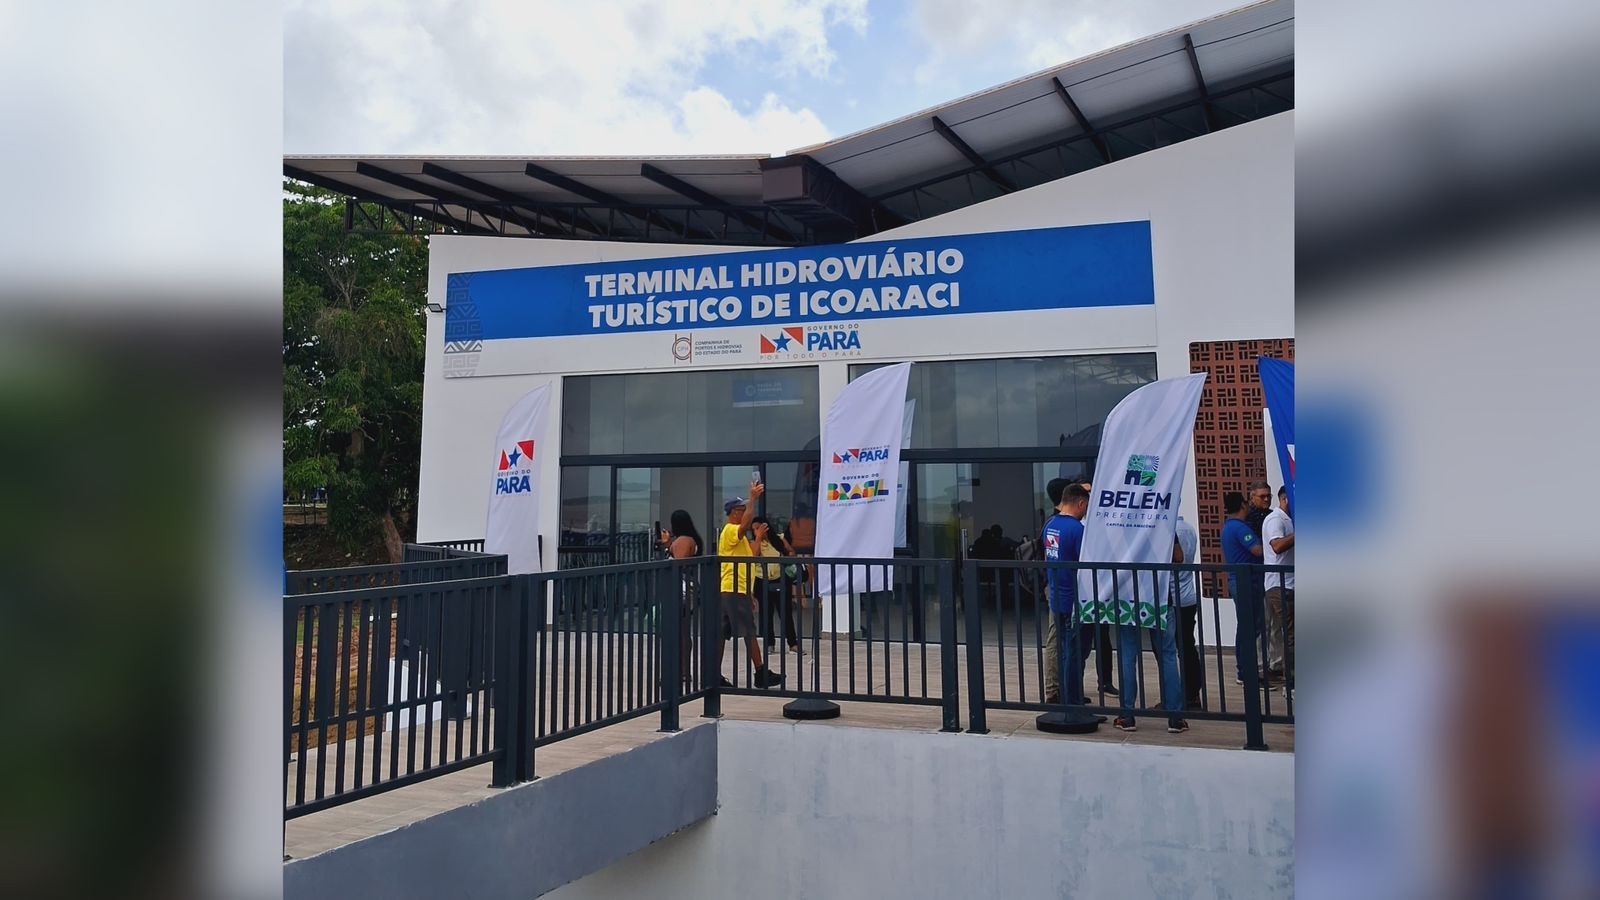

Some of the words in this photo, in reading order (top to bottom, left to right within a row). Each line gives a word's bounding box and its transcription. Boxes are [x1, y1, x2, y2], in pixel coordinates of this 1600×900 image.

[585, 266, 734, 298] TERMINAL
[740, 247, 964, 287] HIDROVIÁRIO
[588, 295, 742, 328] TURÍSTICO
[751, 293, 791, 319] DE
[800, 282, 960, 316] ICOARACI
[827, 479, 889, 501] BRASIL
[1099, 489, 1171, 510] BELÉM
[1096, 511, 1168, 521] PREFEITURA
